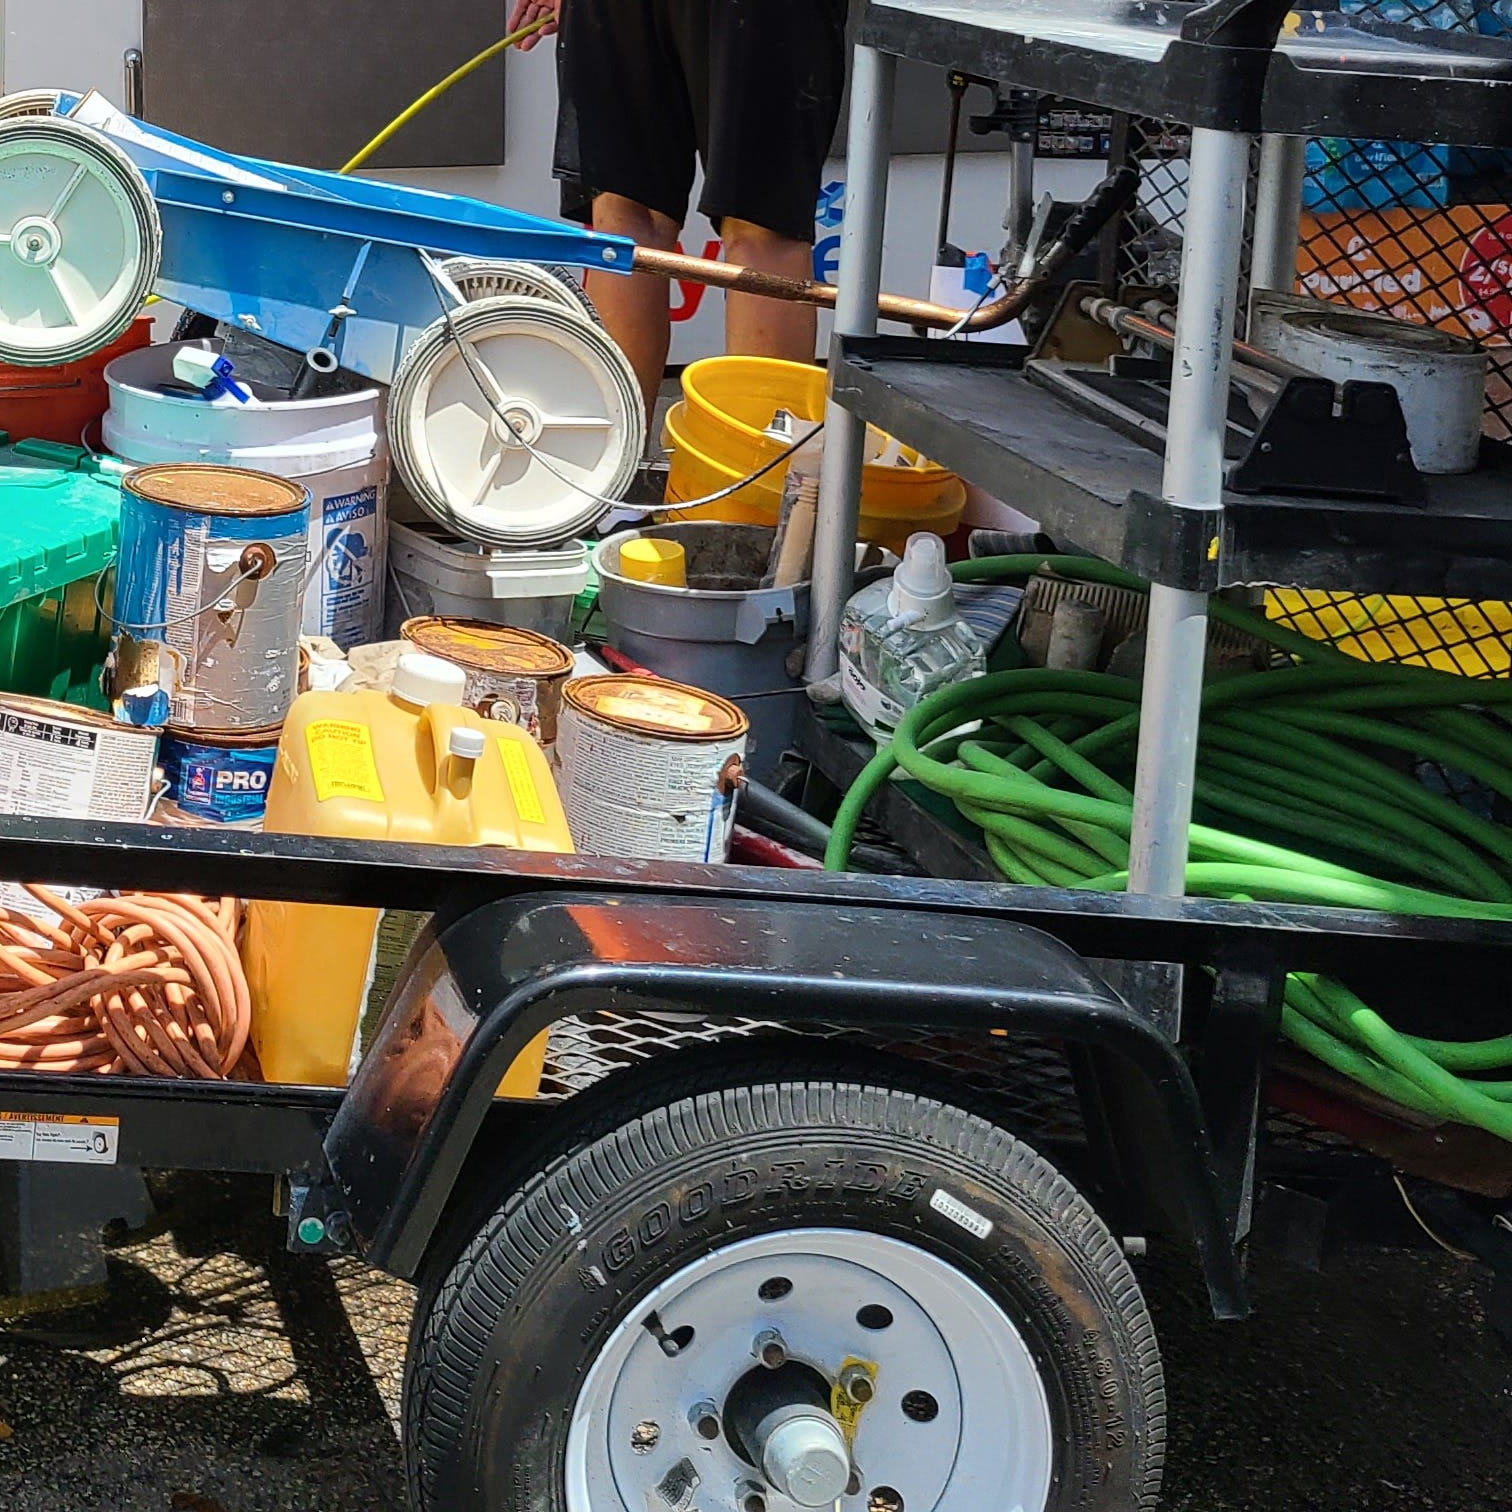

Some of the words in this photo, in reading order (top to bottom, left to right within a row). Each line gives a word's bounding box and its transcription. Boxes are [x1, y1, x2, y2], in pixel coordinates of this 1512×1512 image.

[333, 489, 375, 509] WARNING
[335, 506, 365, 523] AVISO
[216, 770, 267, 790] PRO
[601, 1156, 932, 1271] GOODRIDE
